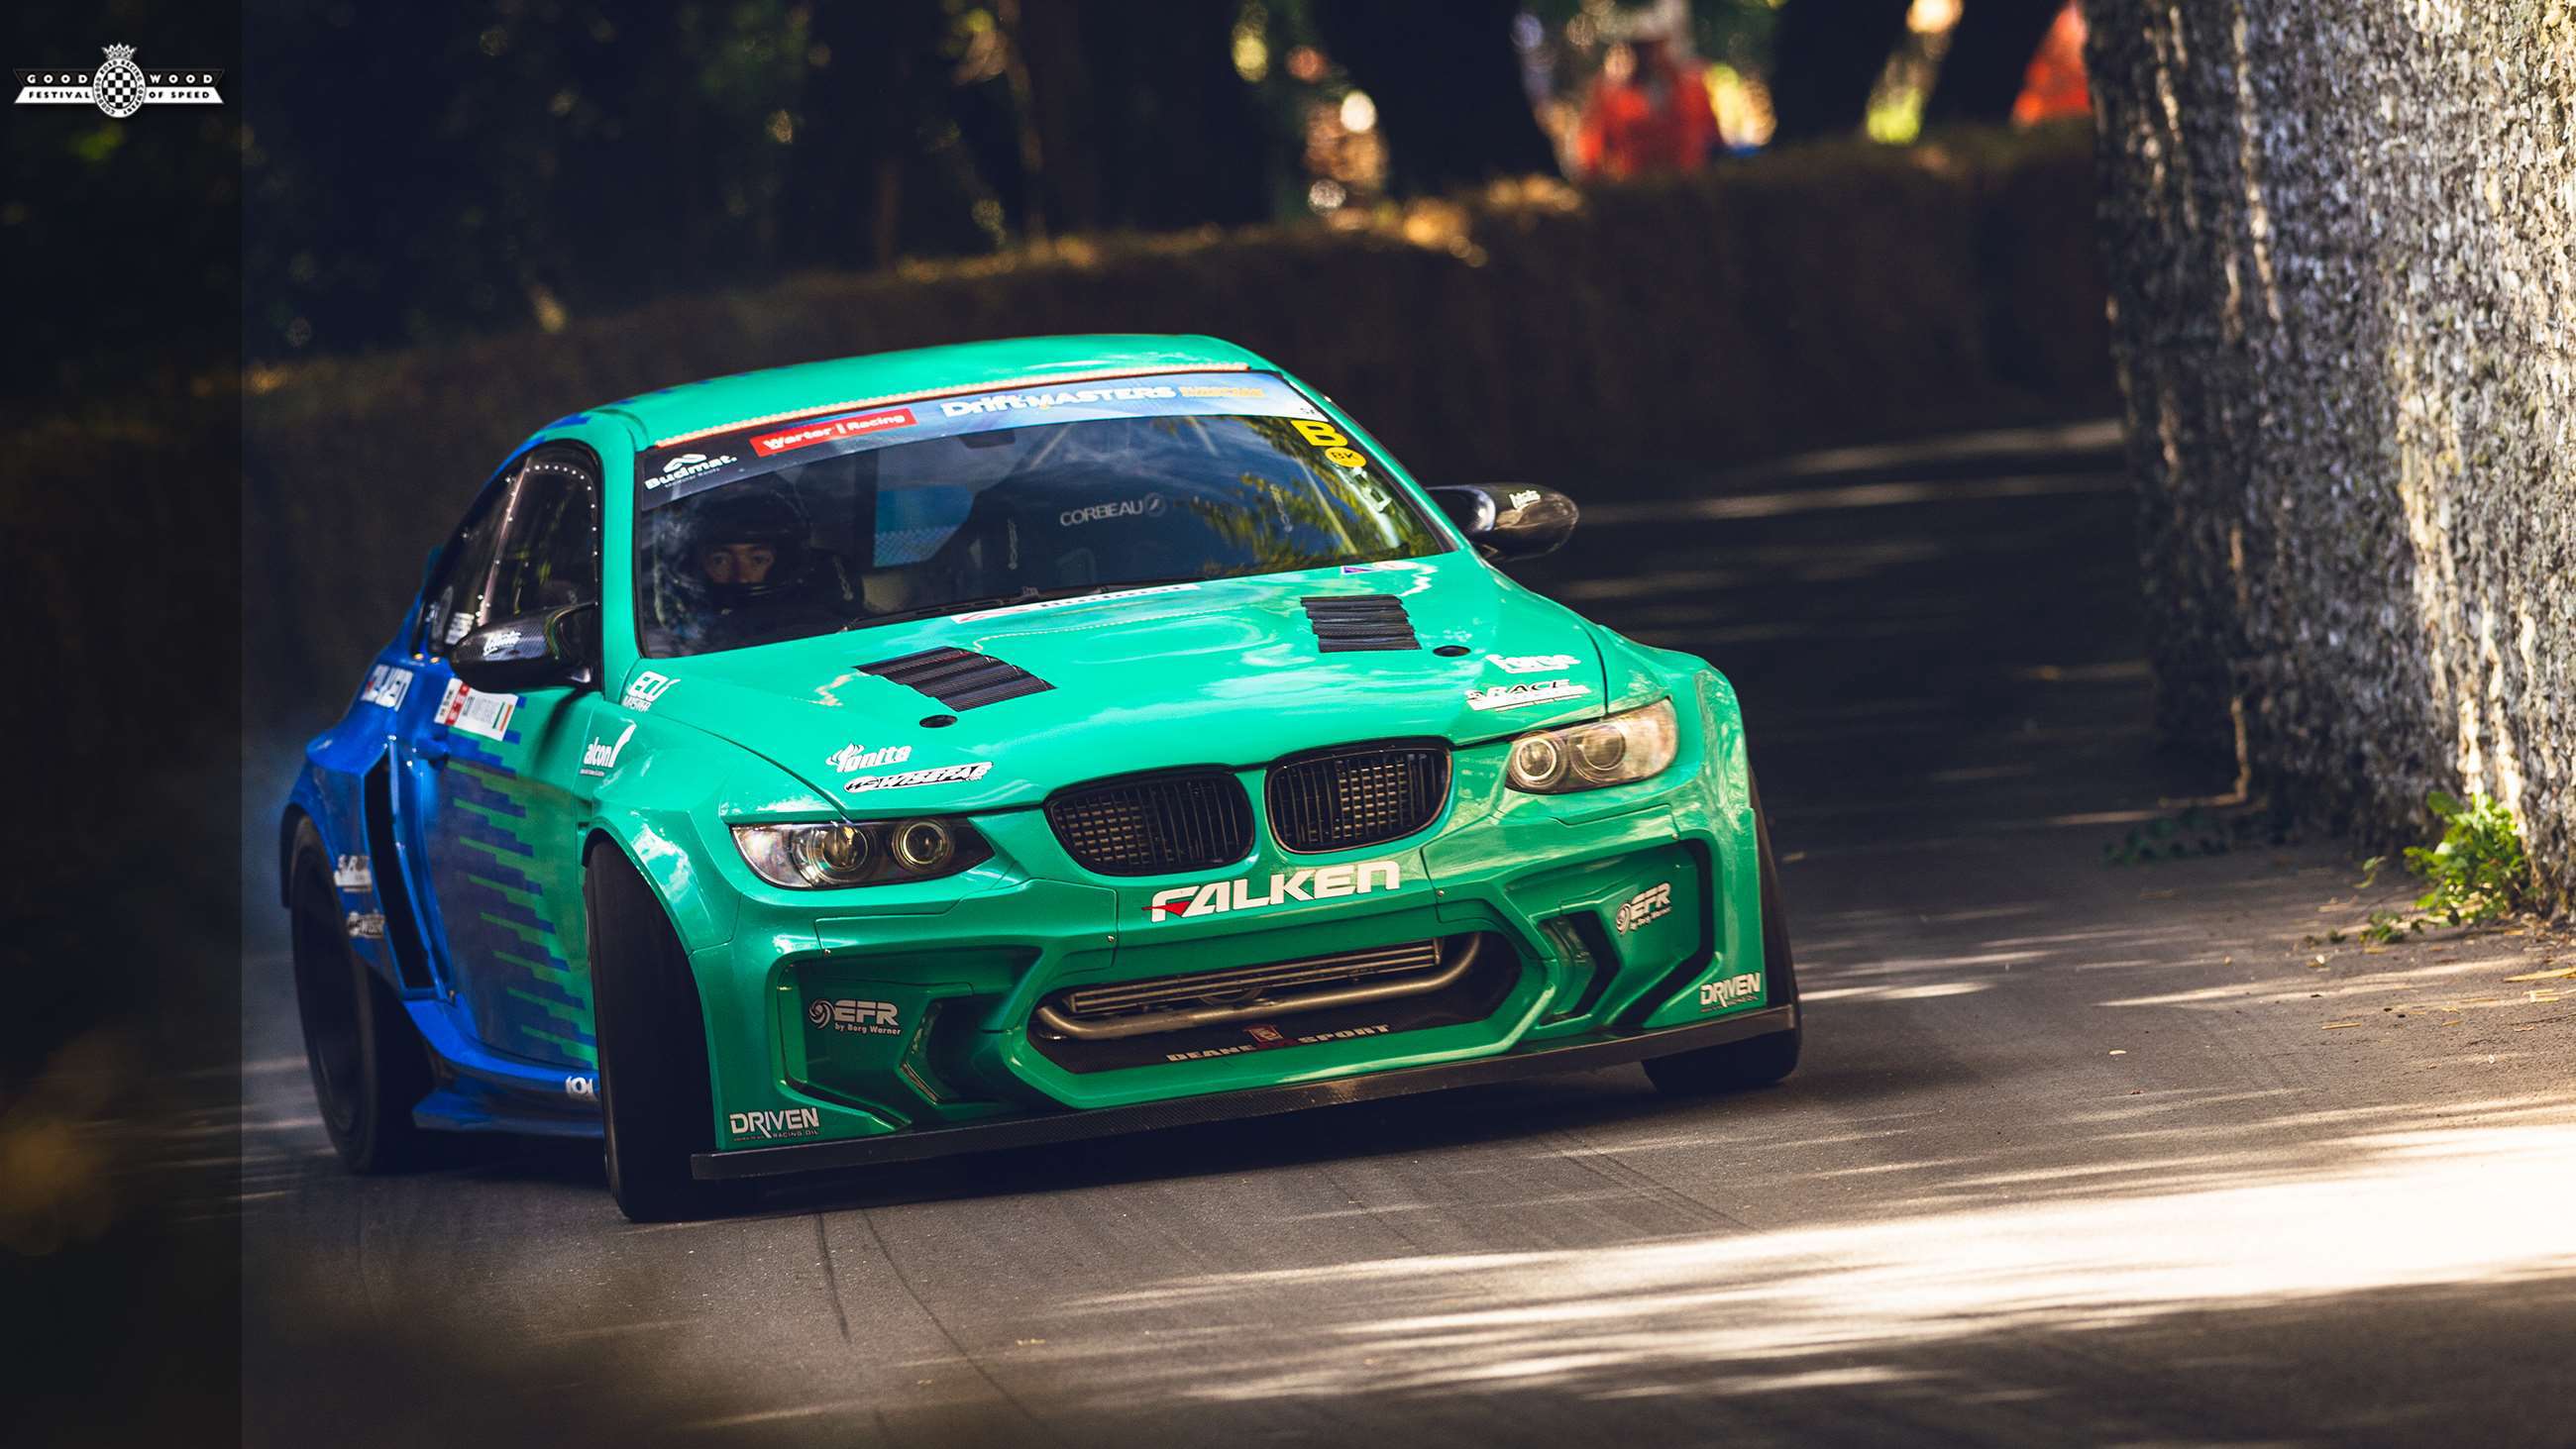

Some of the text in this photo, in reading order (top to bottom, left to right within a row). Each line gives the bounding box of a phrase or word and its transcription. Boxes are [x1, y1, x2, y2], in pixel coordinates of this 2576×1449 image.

[763, 414, 906, 451] Warter Racing
[1290, 420, 1348, 447] B
[1059, 499, 1143, 527] CORBEAU
[1142, 860, 1401, 923] FALKEN
[1630, 882, 1671, 920] EFR
[1699, 972, 1761, 1008] DRIVEN
[833, 999, 900, 1026] EFR
[834, 1022, 903, 1036] by Borg Warner
[1166, 1023, 1391, 1063] DEANE SPORT
[728, 1106, 820, 1138] DRIVEN
